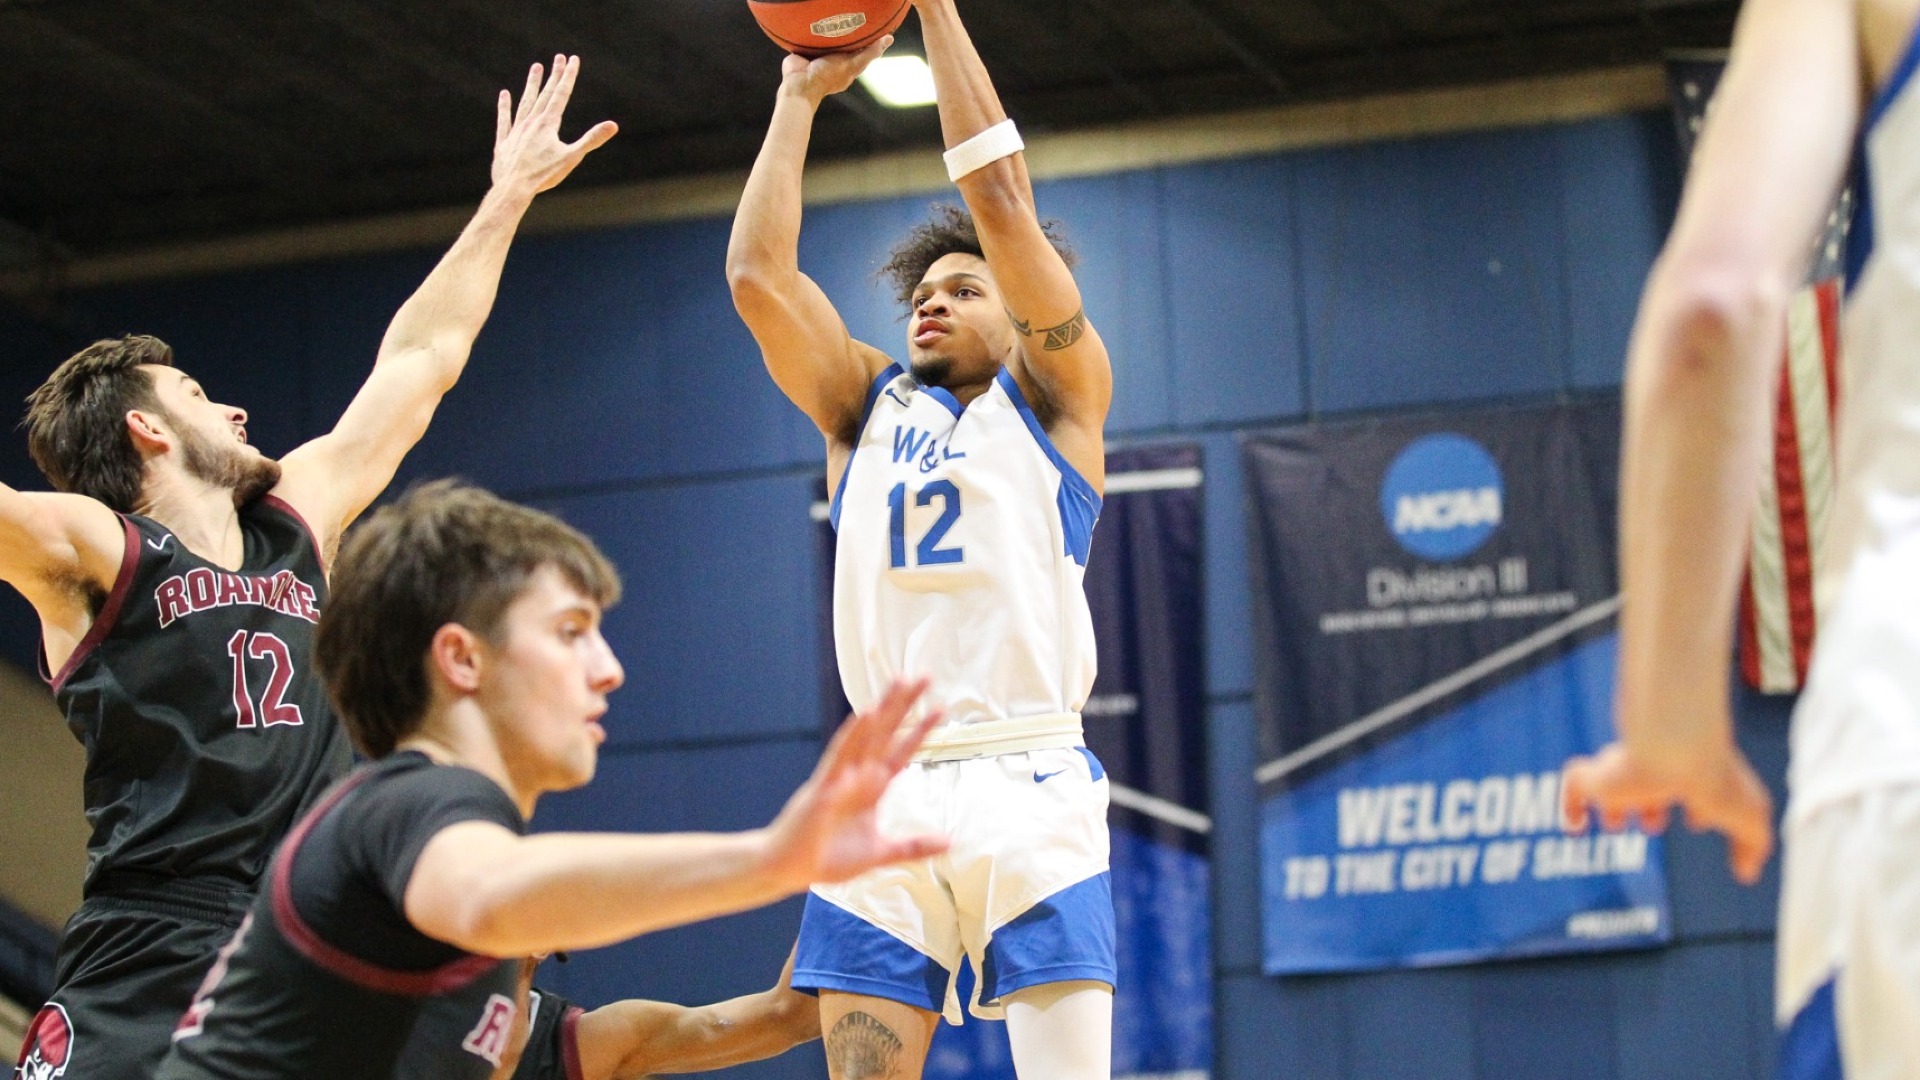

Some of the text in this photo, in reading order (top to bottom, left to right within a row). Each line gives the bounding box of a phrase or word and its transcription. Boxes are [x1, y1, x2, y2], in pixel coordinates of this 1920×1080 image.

[886, 477, 966, 570] 12
[227, 629, 304, 729] 12
[1337, 771, 1570, 847] WELCOM
[1284, 854, 1330, 899] TO
[1335, 849, 1396, 895] THE
[1401, 844, 1479, 891] CITY
[1482, 838, 1529, 884] OF
